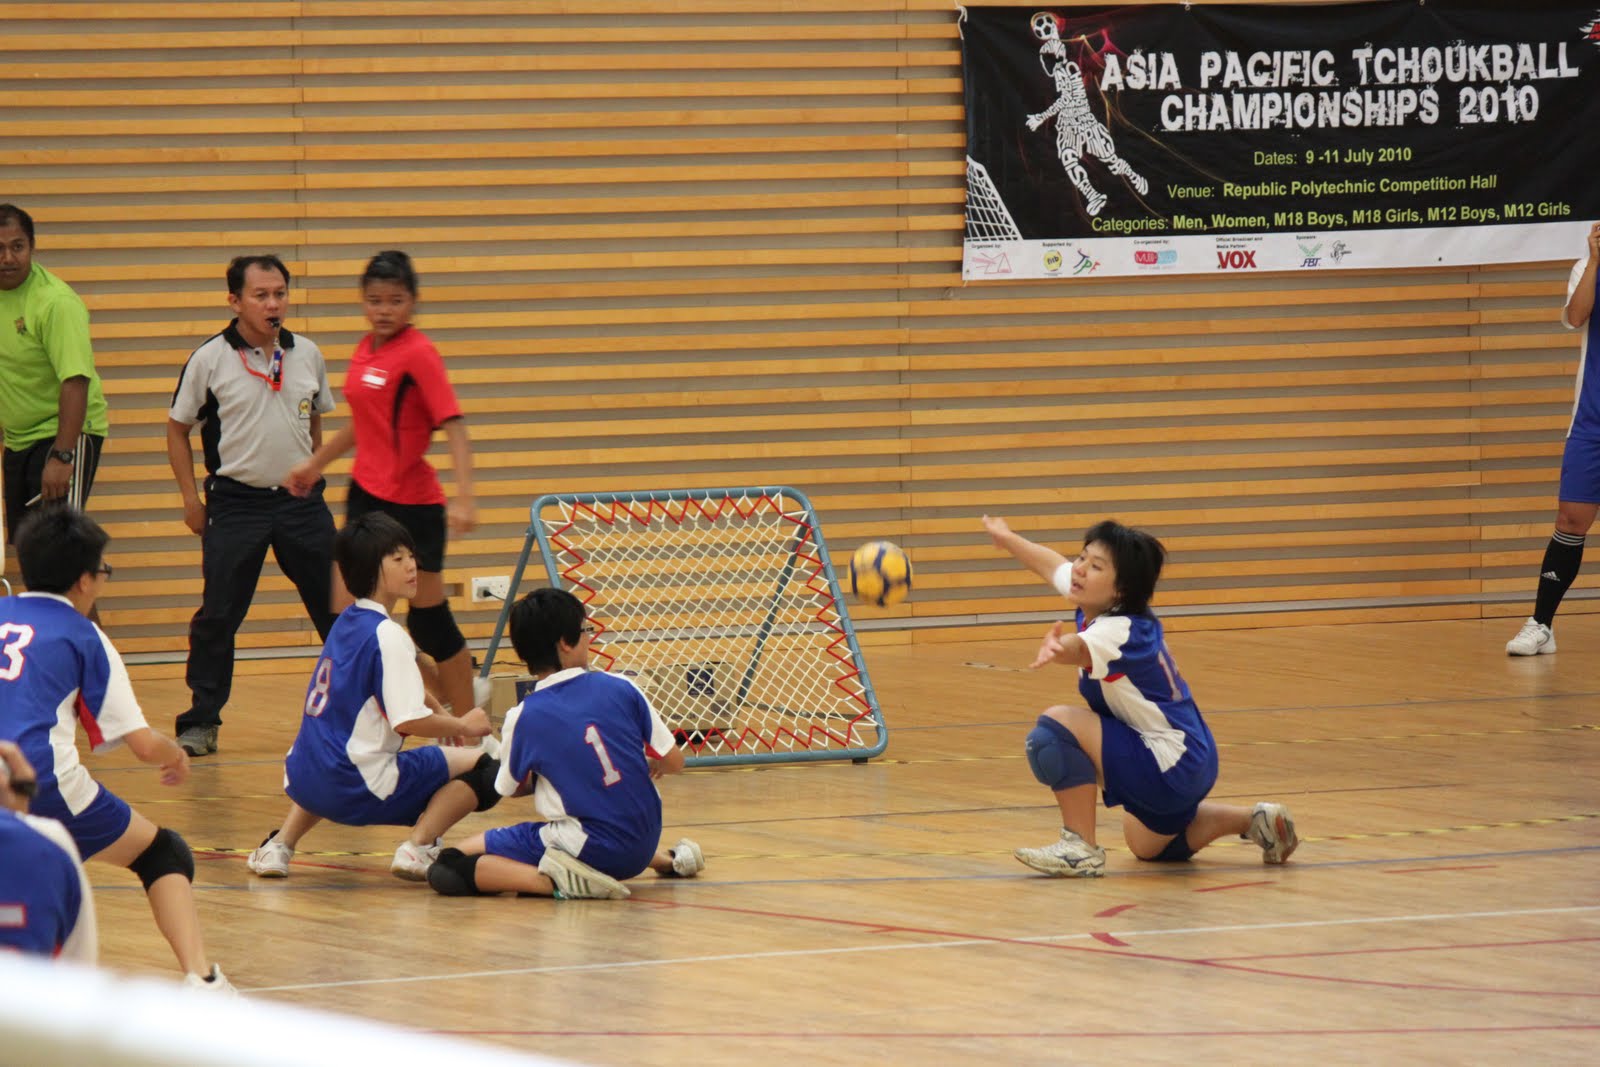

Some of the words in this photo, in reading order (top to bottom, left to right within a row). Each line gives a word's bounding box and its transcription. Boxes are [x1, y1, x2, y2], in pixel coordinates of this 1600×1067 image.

[1100, 49, 1182, 91] ASIA
[1200, 50, 1336, 88] PACIFIC
[1352, 41, 1580, 85] TCHOUKBALL
[1160, 87, 1440, 131] CHAMPIONSHIPS
[1459, 82, 1539, 124] 2010
[1099, 154, 1148, 195] PAKISTAN
[1254, 151, 1297, 165] Dates:
[1306, 151, 1314, 164] 9
[1319, 150, 1339, 163] -11
[1344, 148, 1374, 166] July
[1378, 147, 1412, 162] 2010
[1167, 184, 1215, 198] Venue:
[1223, 181, 1287, 199] Republic
[1291, 179, 1375, 198] Polytechnic
[1379, 176, 1466, 194] Competition
[1470, 174, 1498, 189] Hall
[1092, 216, 1169, 234] Categories:
[1173, 214, 1207, 230] Men,
[1211, 213, 1270, 230] Women,
[1274, 212, 1304, 226] M18
[1308, 211, 1348, 229] Boys,
[1352, 209, 1381, 223] M18
[1386, 208, 1424, 225] Girls,
[1428, 207, 1457, 221] M12
[1460, 205, 1500, 223] Boys,
[1504, 203, 1534, 218] M12
[1537, 201, 1571, 216] Girls
[1217, 250, 1257, 269] VOX
[0, 622, 34, 681] 3
[305, 656, 333, 718] 8
[584, 722, 622, 788] 1
